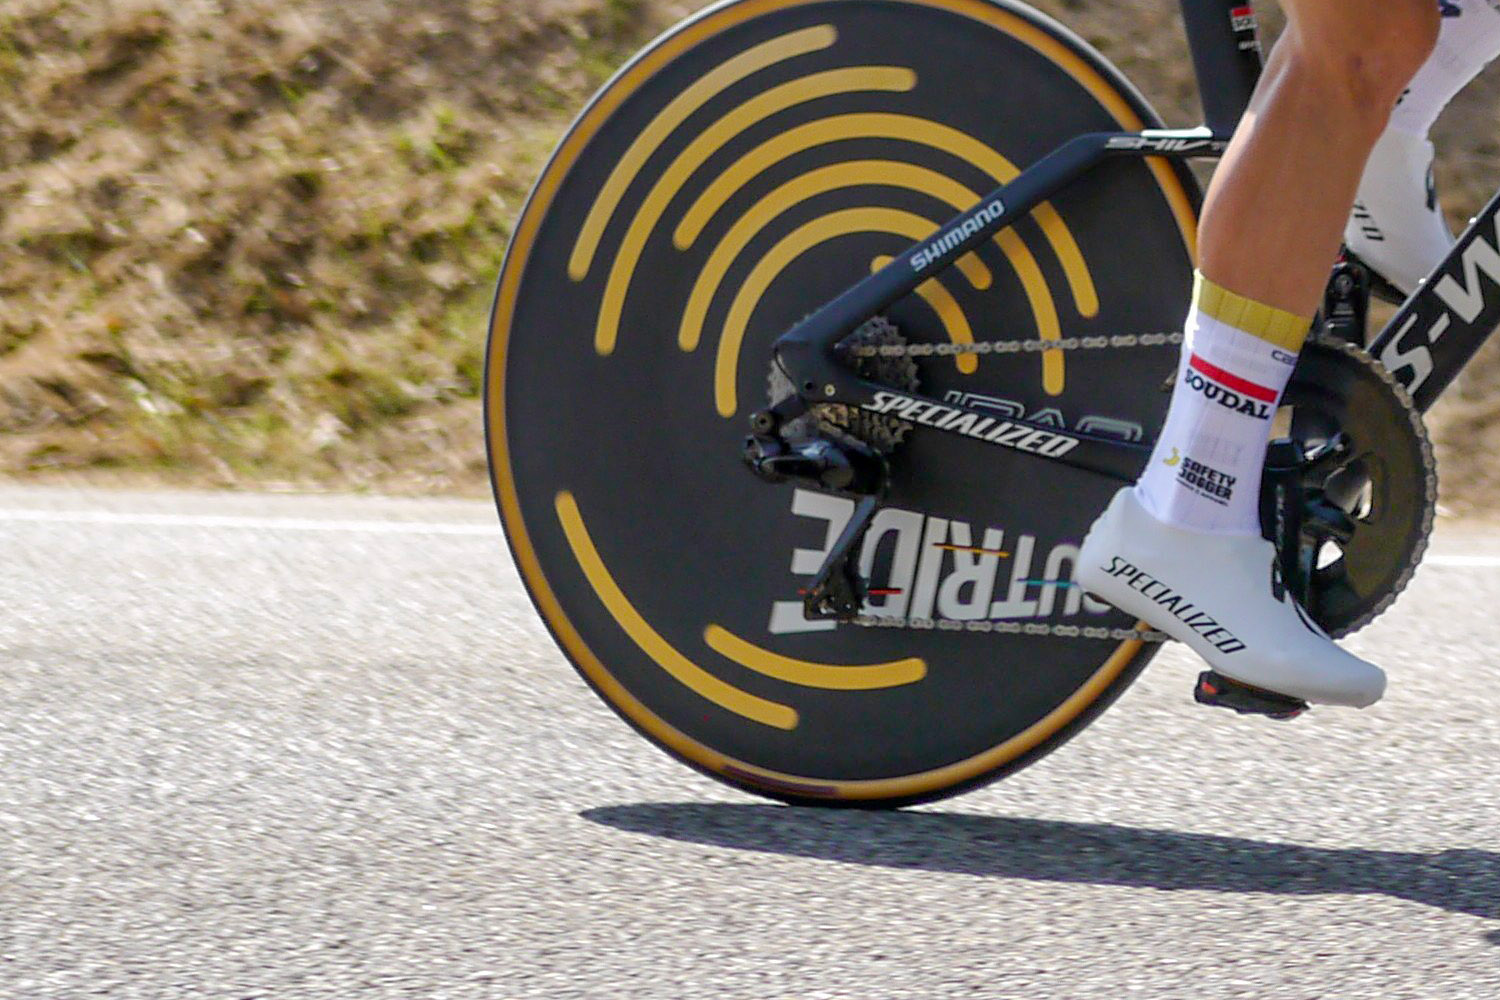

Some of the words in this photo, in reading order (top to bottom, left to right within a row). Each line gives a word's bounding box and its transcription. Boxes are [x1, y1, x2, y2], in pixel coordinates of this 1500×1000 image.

[910, 200, 1005, 273] SHIMANO
[859, 390, 1080, 459] SPECIALIZED
[1184, 368, 1271, 421] SOUDAL
[1177, 467, 1233, 500] JOGGER
[1182, 456, 1237, 488] SAFETY
[768, 488, 1112, 634] UTRIDE
[1100, 555, 1247, 655] SPECIALIZED
